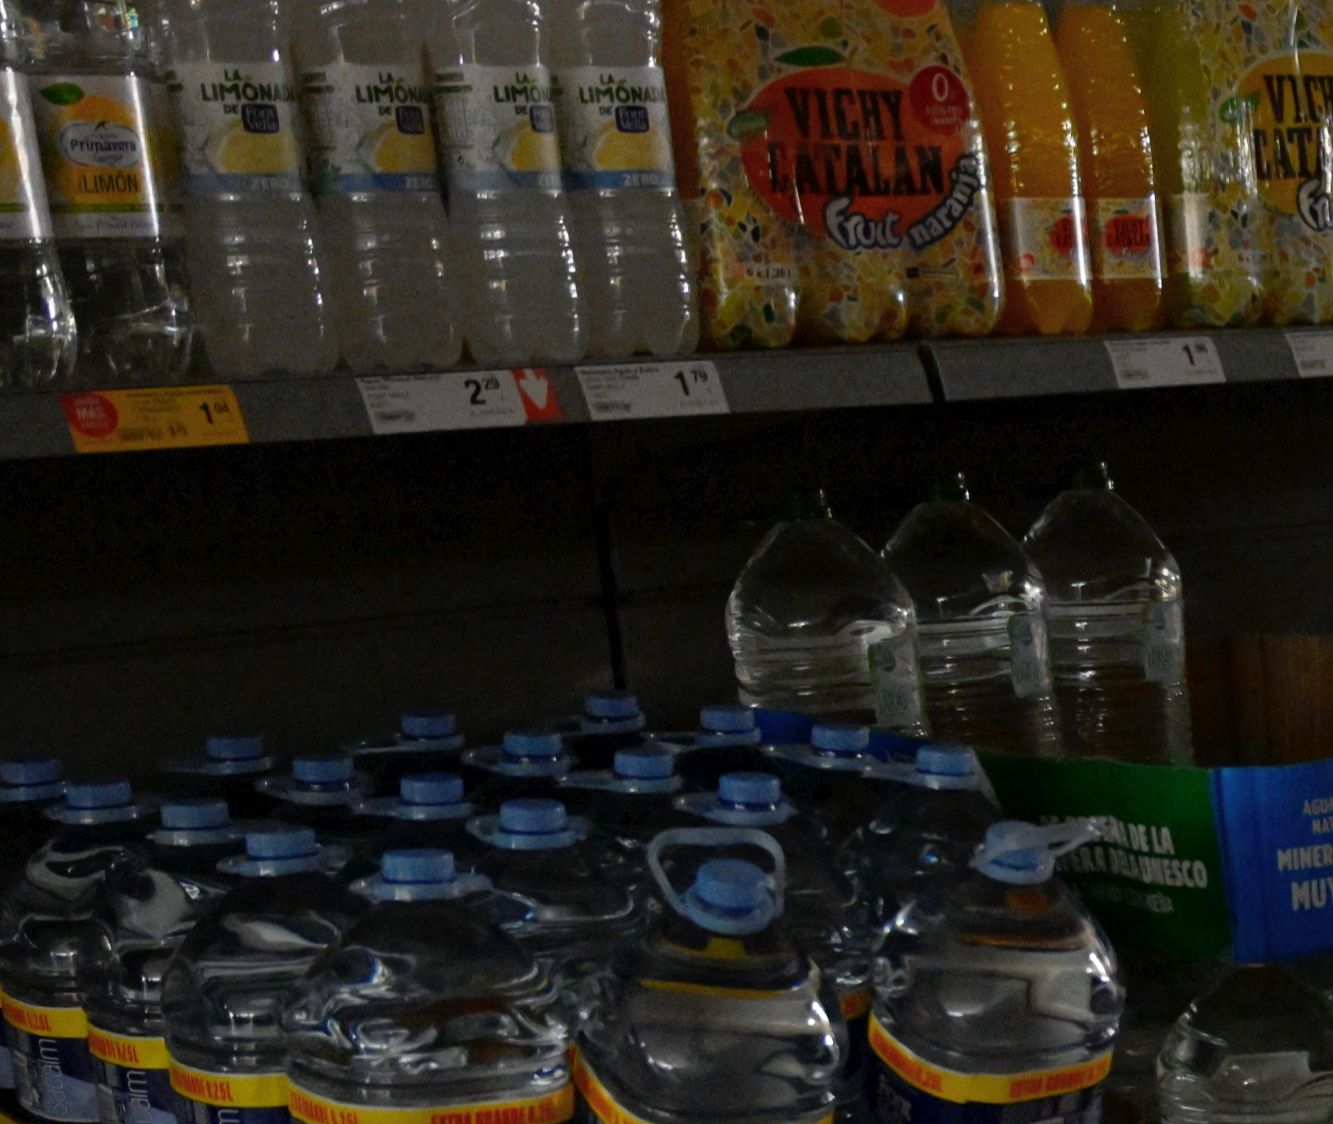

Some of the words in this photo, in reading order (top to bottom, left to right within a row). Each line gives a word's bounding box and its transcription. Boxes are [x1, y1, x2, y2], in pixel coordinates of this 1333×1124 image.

[784, 86, 905, 141] VICHY
[70, 139, 137, 153] Primavera
[768, 142, 944, 196] CATALAN
[81, 172, 138, 194] LIMÓN
[907, 154, 980, 250] naranja
